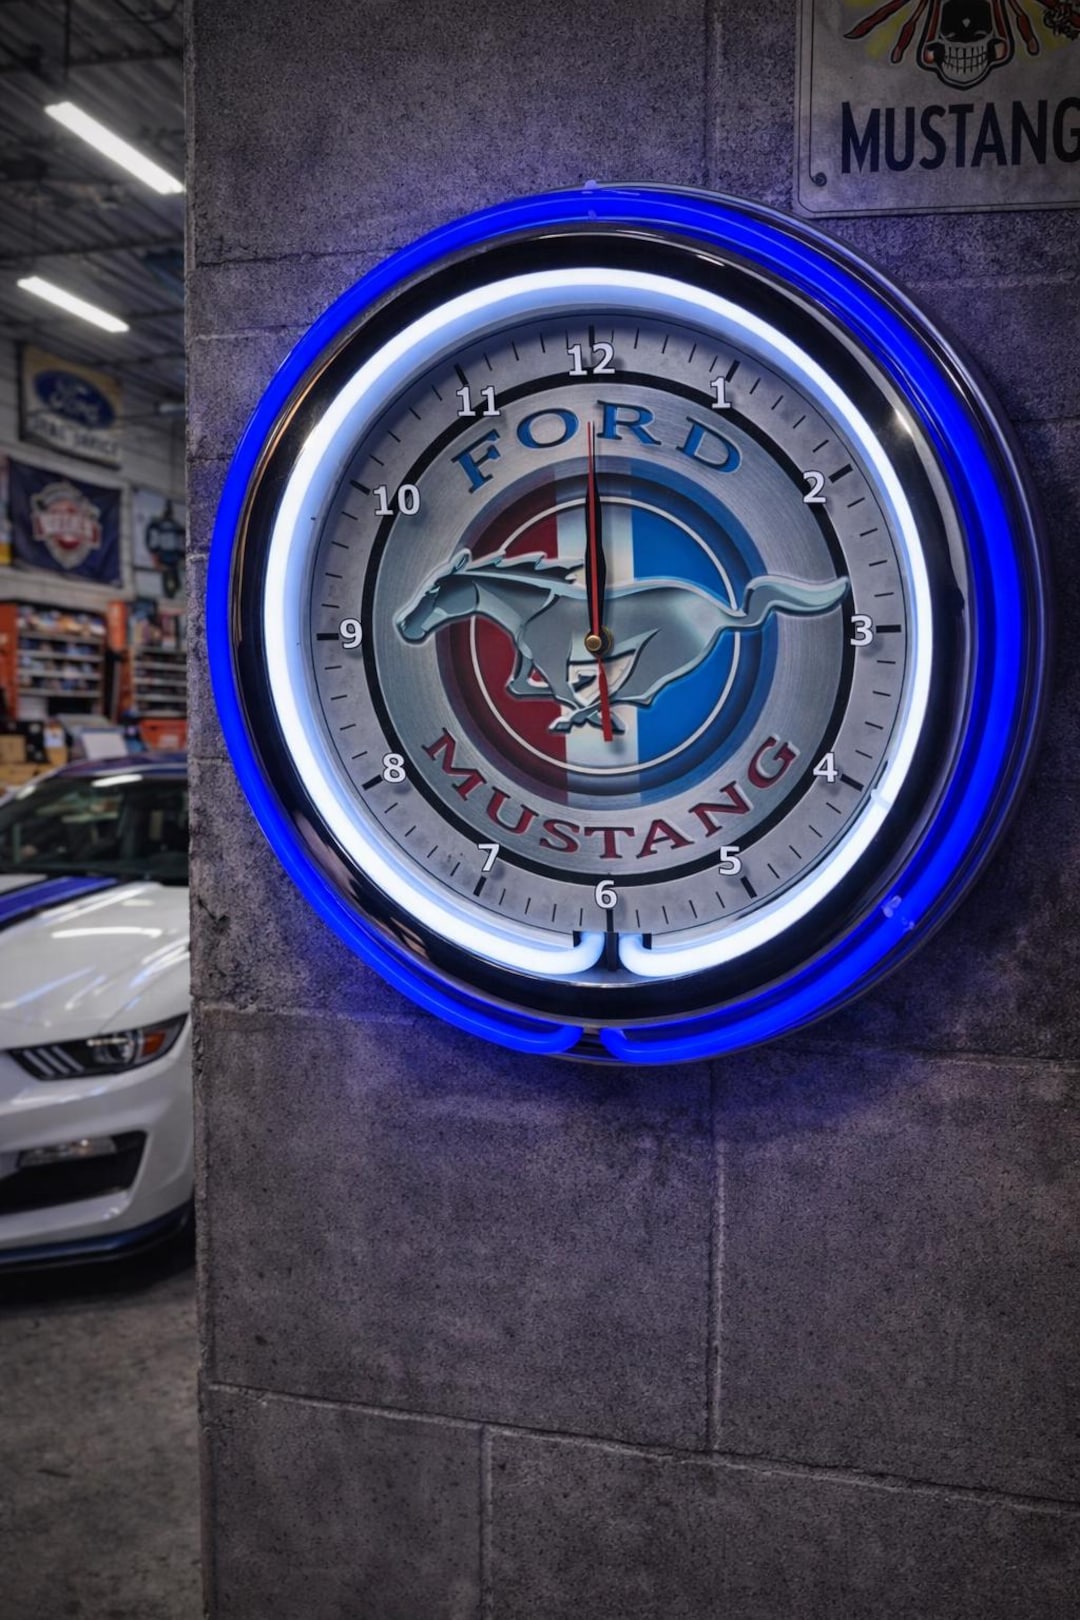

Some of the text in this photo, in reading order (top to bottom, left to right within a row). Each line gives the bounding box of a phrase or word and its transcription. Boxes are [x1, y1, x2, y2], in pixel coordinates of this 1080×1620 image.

[841, 97, 1080, 174] MUSTANG
[567, 343, 616, 376] 12
[456, 385, 501, 417] 11
[709, 376, 732, 410] 1
[451, 399, 743, 494] FORD
[373, 483, 421, 516] 10
[802, 470, 827, 504] 2
[339, 618, 363, 649] 9
[850, 614, 874, 647] 3
[381, 752, 406, 784] 8
[812, 751, 838, 783] 4
[421, 727, 799, 860] MUSTANG
[477, 843, 500, 873] 7
[718, 845, 742, 876] 5
[594, 879, 618, 909] 6
